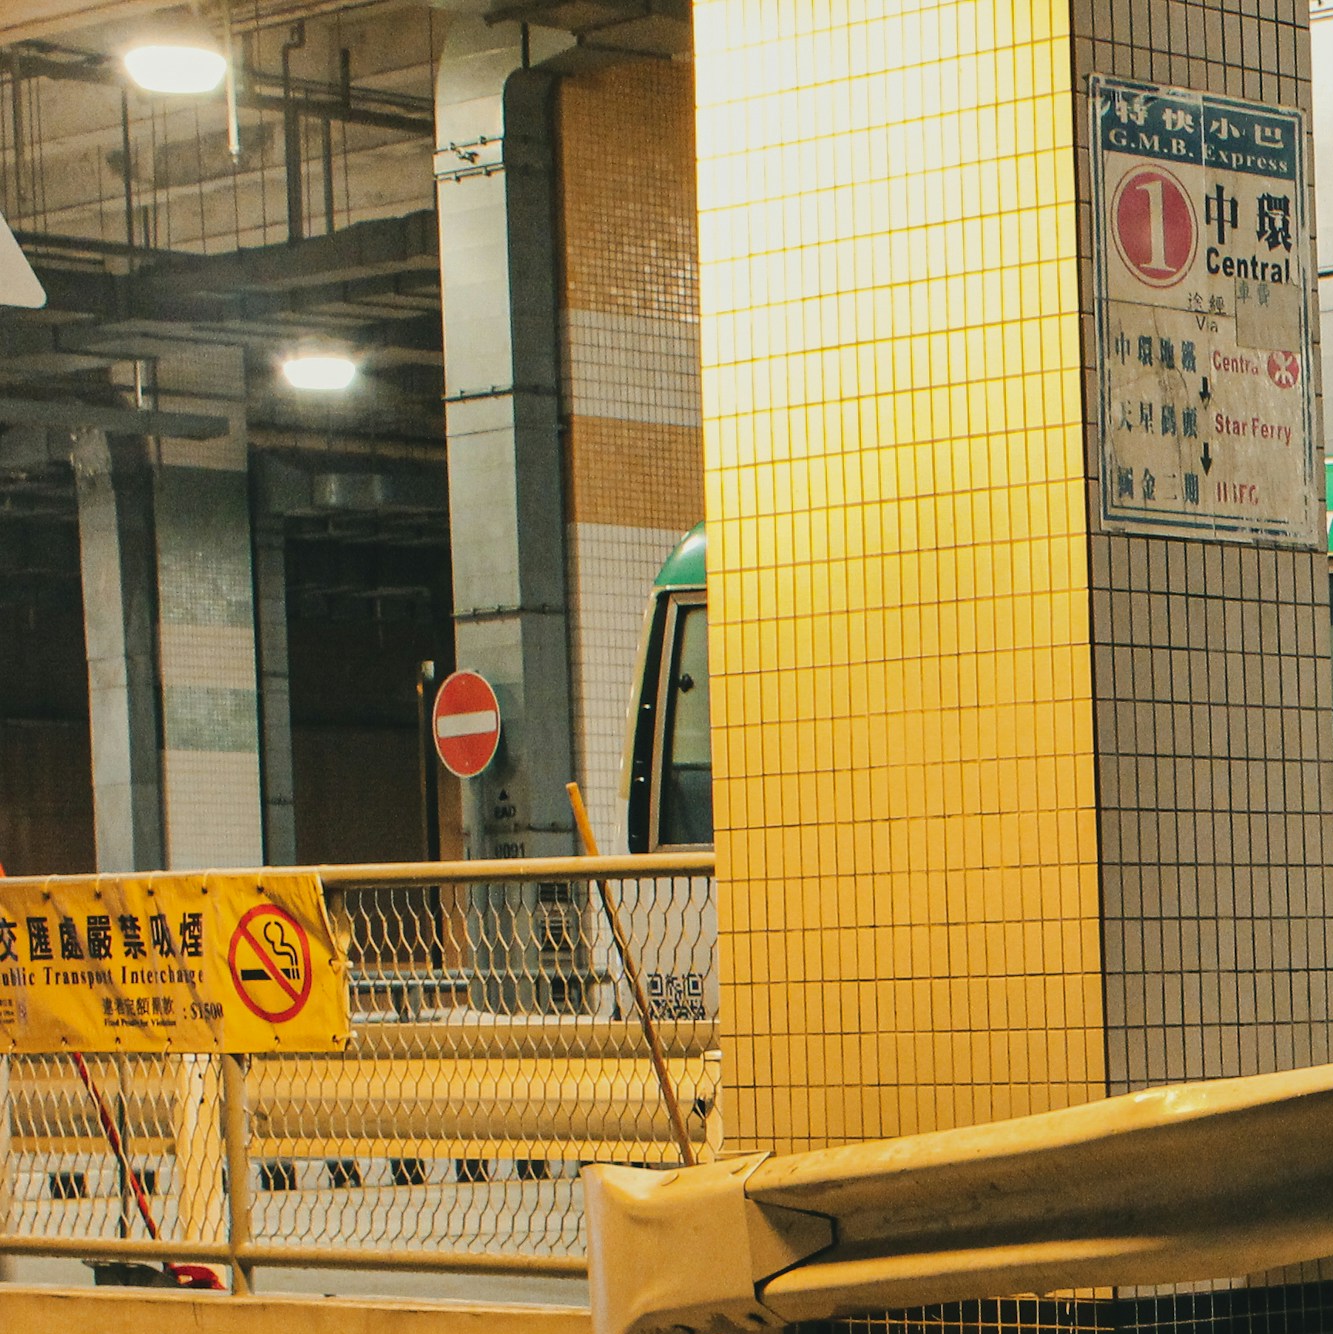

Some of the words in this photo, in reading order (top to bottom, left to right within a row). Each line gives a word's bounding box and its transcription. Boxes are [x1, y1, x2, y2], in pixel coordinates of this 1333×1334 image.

[1114, 96, 1284, 148] 特快小巴
[1109, 128, 1194, 158] G.M.B.
[1204, 143, 1288, 173] Express
[1136, 180, 1177, 272] 1
[1205, 184, 1292, 252] 中環
[1206, 247, 1289, 284] Central
[1188, 292, 1226, 315] 途經
[1196, 315, 1218, 333] Via
[1213, 350, 1259, 375] Centra
[1215, 413, 1247, 437] Star
[1252, 417, 1291, 447] Ferry
[43, 966, 114, 989] Transport
